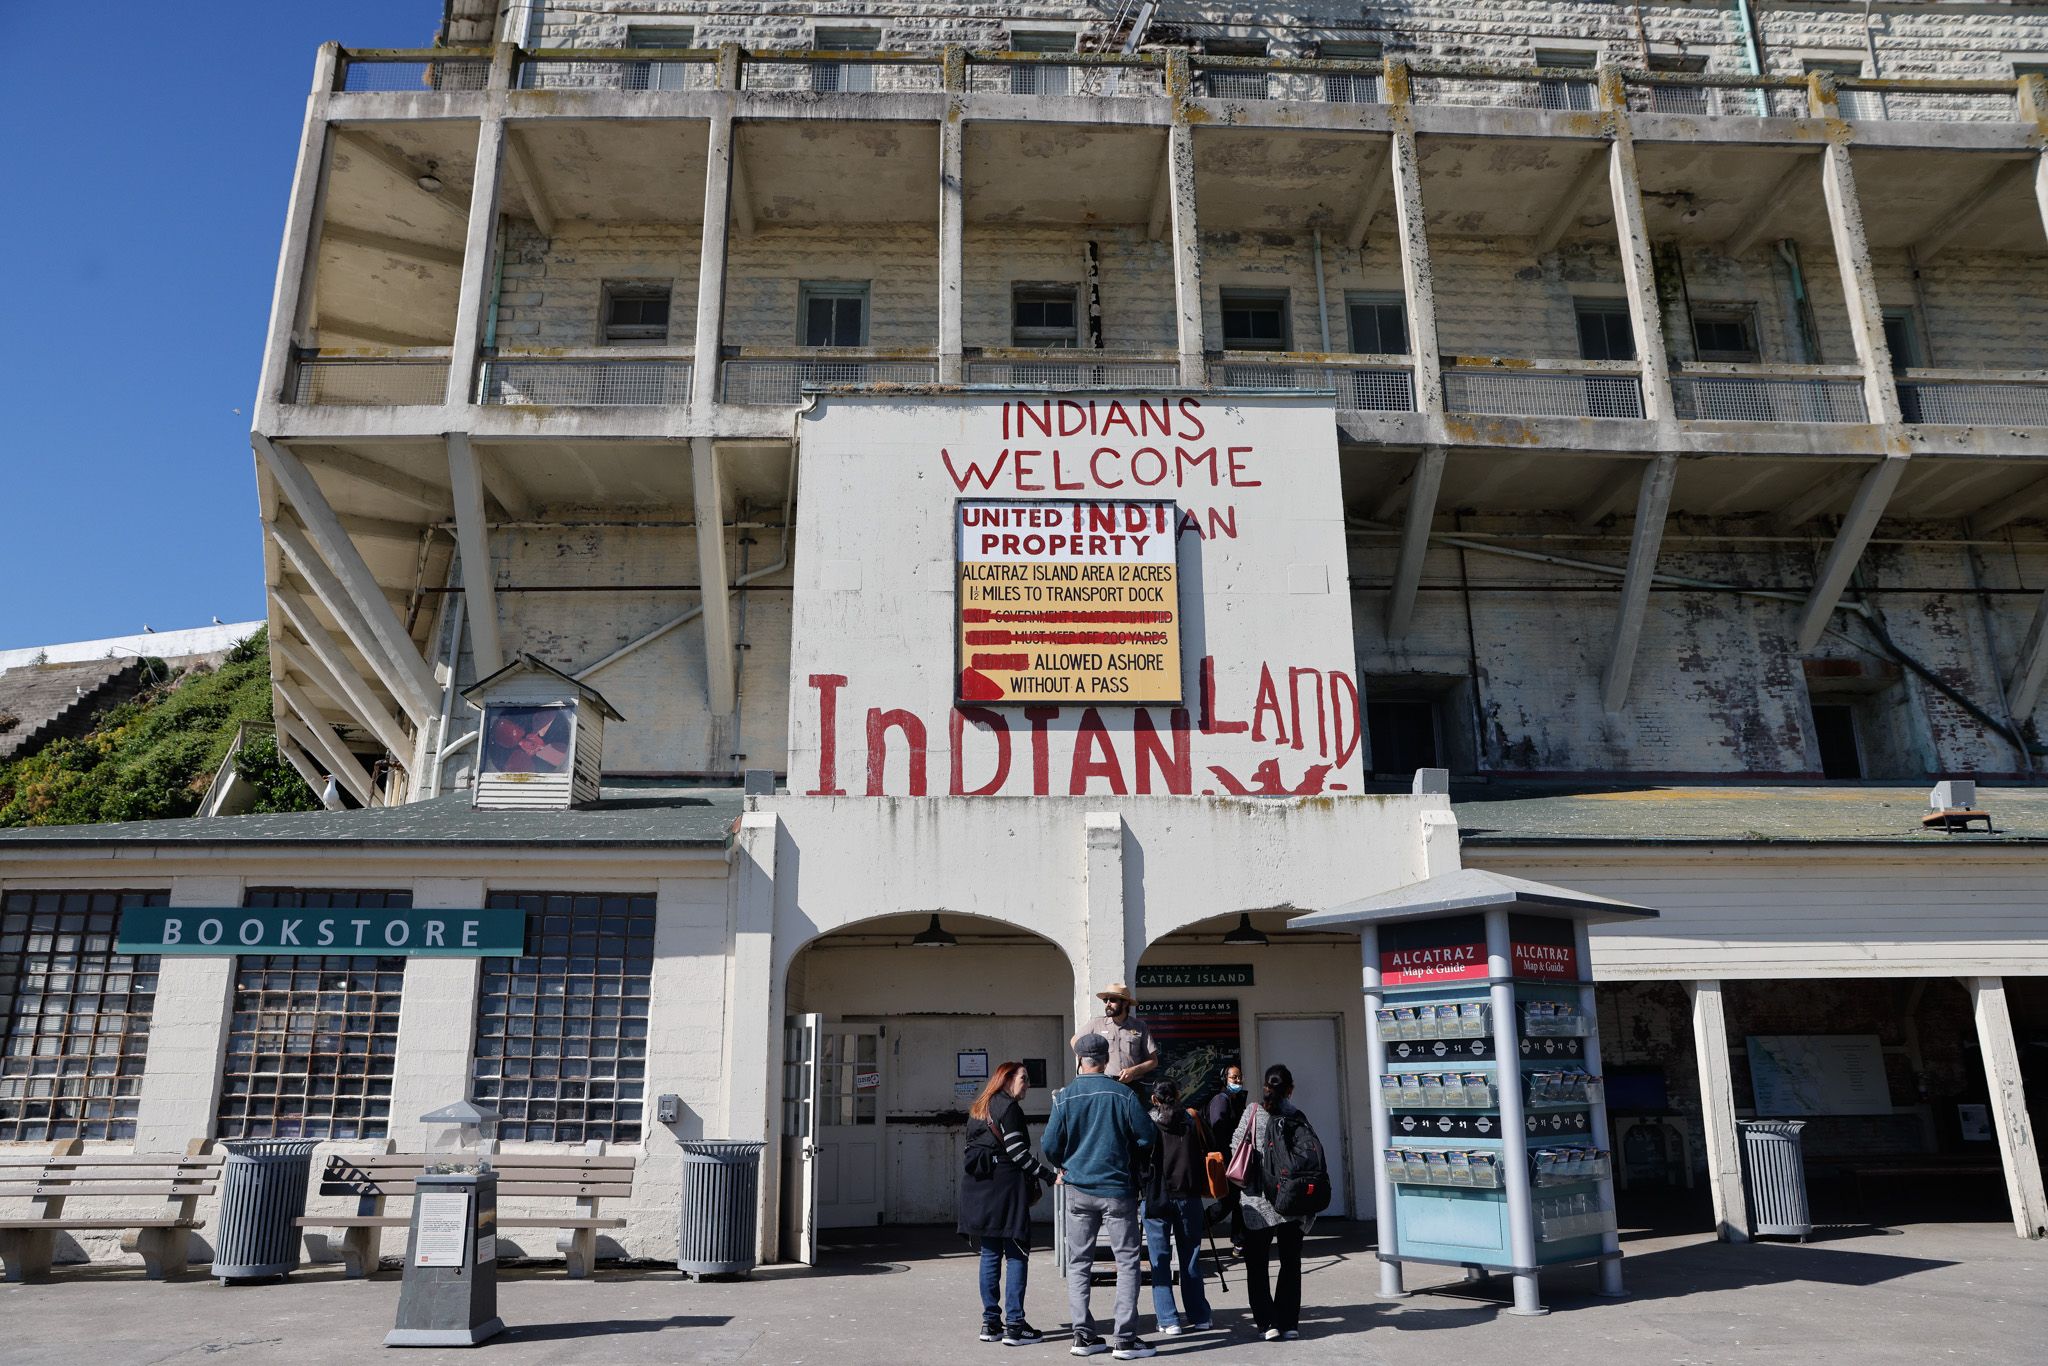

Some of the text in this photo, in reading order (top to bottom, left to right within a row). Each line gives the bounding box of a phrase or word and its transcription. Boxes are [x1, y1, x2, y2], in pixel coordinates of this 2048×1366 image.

[1003, 398, 1204, 441] INDIANS
[942, 446, 1262, 492] WELCOME
[963, 508, 1063, 528] UNITED
[981, 533, 1150, 556] PROPERTY
[962, 565, 1172, 582] ALCATRAZ ISLAND AREA 12 ACRES
[982, 586, 1021, 601] MILES
[1024, 587, 1042, 602] TO
[1047, 586, 1124, 602] TRANSPORT
[1129, 587, 1164, 602] DOCK
[1034, 653, 1164, 671] ALLOWED ASHORE
[1010, 677, 1129, 693] WITHOUT A PASS
[161, 918, 480, 947] BOOKSTORE
[1392, 946, 1475, 966] ALCATRAZ
[1516, 945, 1570, 961] ALCATRAZ
[1402, 966, 1424, 978] Map
[1435, 963, 1466, 975] Guide
[1523, 960, 1564, 973] Map & Guide
[1136, 973, 1246, 984] CATRAZ ISLAND
[1137, 1003, 1174, 1011] ODAY'S
